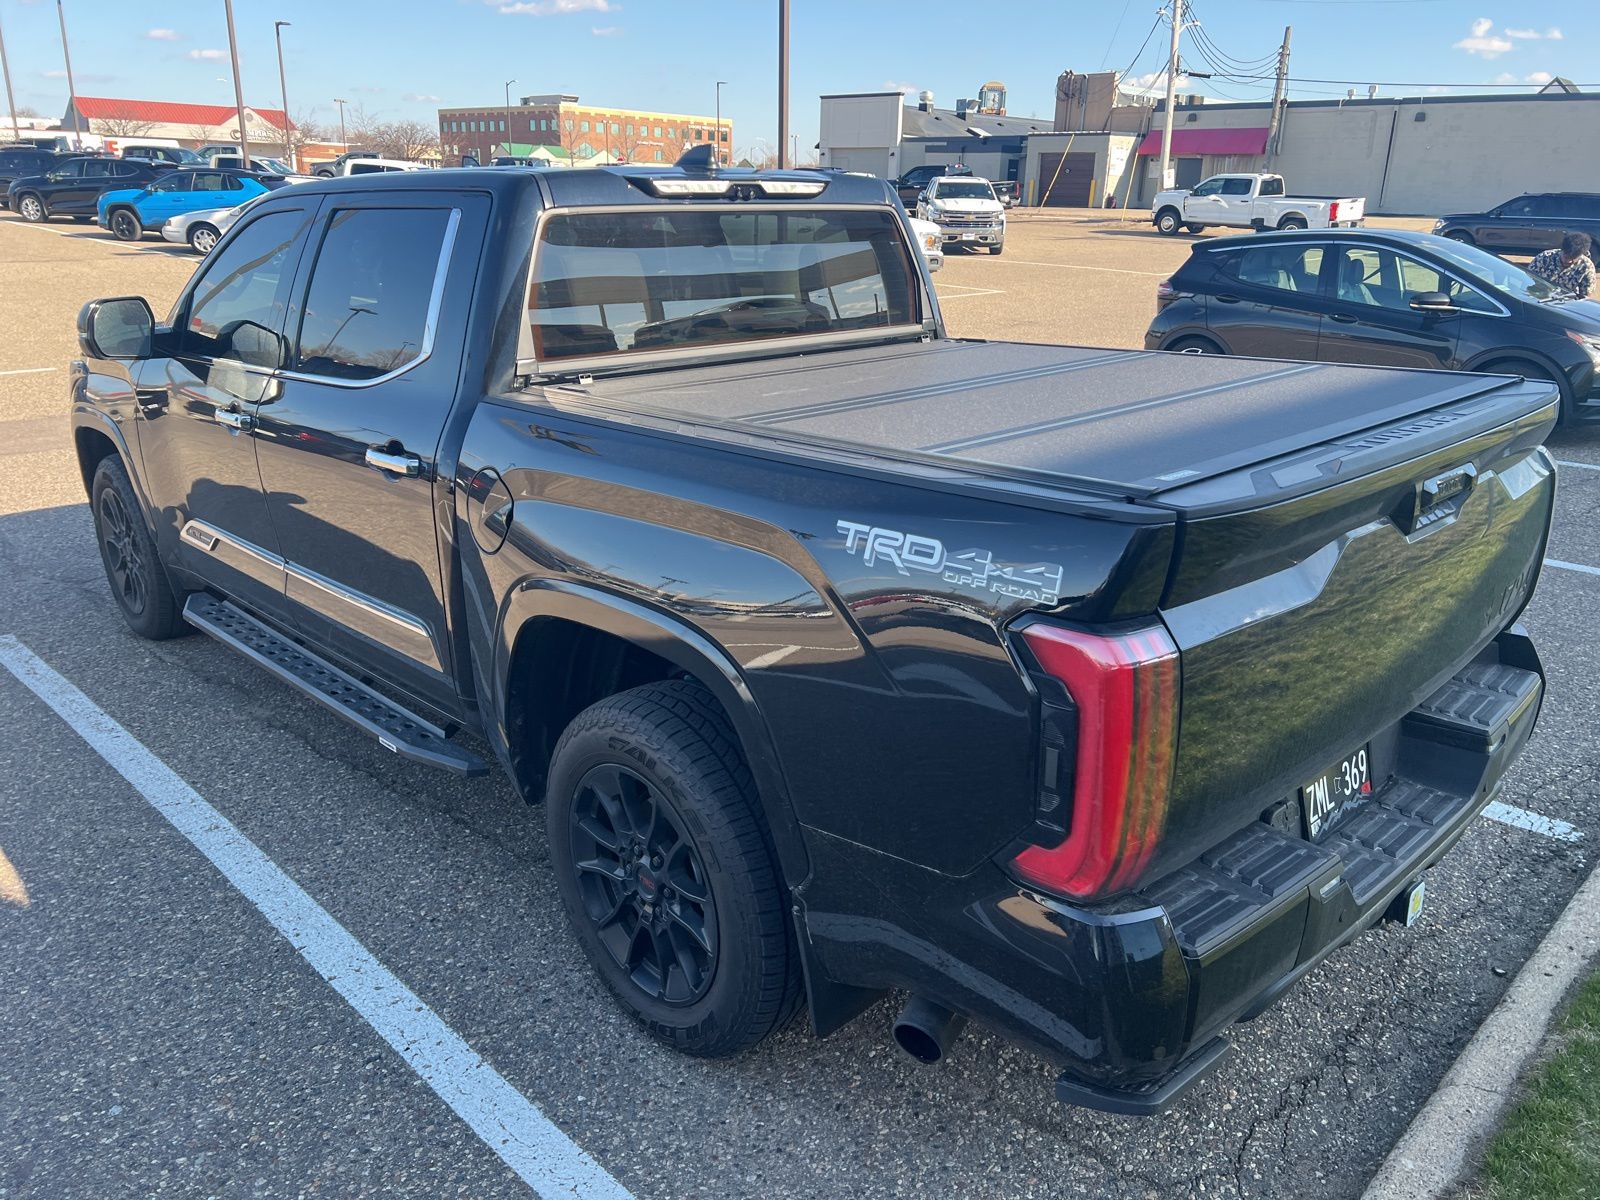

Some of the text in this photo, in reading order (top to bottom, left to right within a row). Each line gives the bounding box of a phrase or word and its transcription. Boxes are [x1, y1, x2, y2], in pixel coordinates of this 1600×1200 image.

[837, 520, 947, 576] TRD
[943, 570, 1059, 607] OFF ROAD
[1306, 749, 1367, 824] ZML 369
